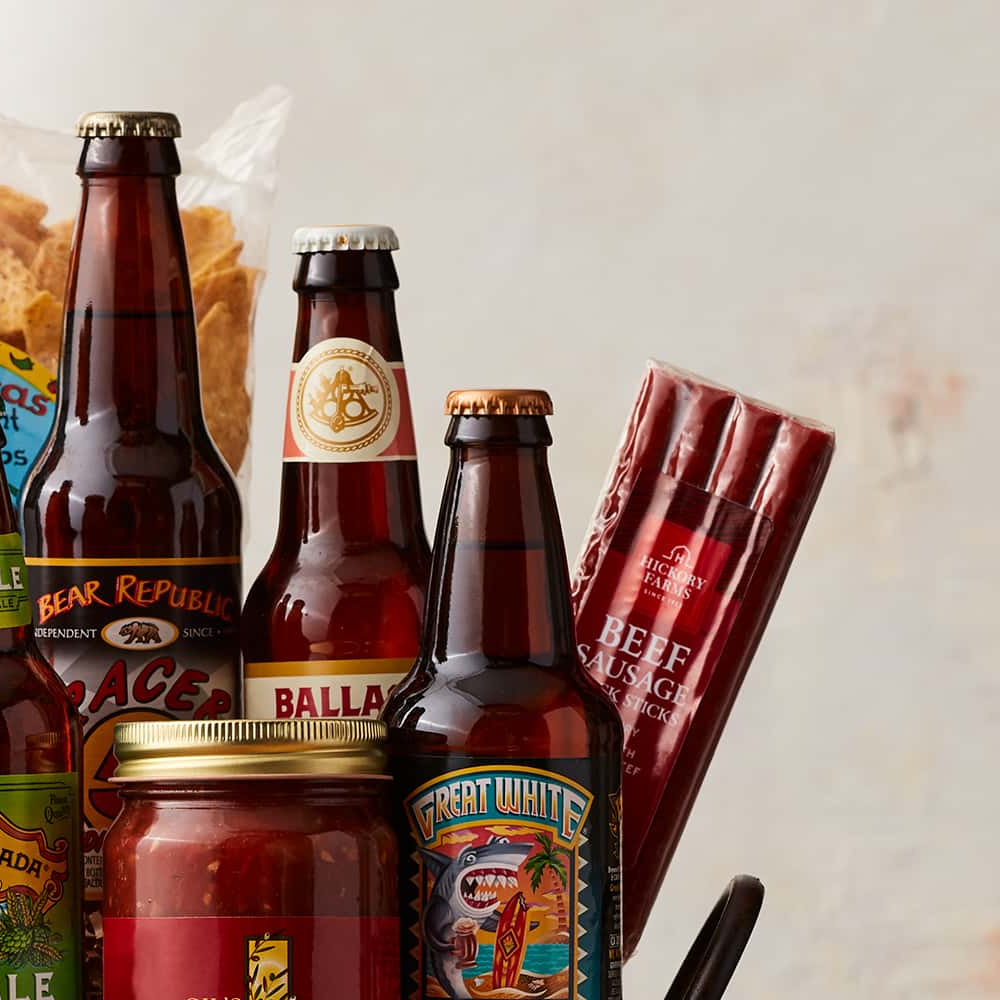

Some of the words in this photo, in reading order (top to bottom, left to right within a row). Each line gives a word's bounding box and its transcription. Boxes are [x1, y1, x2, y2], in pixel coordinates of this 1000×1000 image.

[640, 555, 707, 591] HICKORY
[643, 572, 692, 600] FARMS
[37, 580, 113, 624] BEAR
[114, 574, 233, 622] REPUBLIC
[183, 627, 213, 638] SINCE
[596, 613, 691, 673] BEEF
[577, 643, 689, 707] SAUSAGE
[275, 684, 397, 719] BALLA
[622, 694, 680, 727] STICKS
[411, 778, 491, 841] GREAT
[495, 776, 586, 839] WHITE
